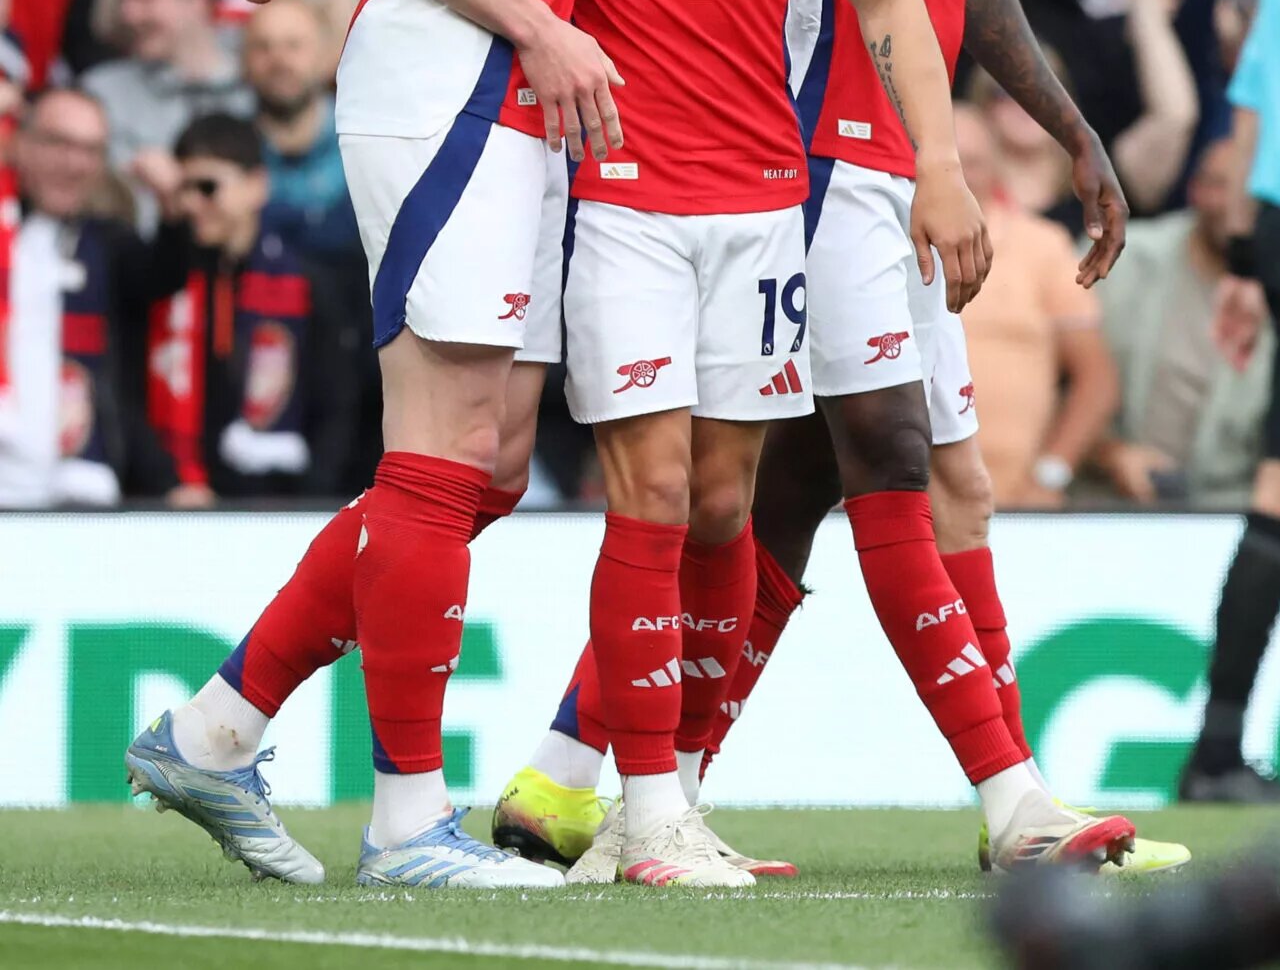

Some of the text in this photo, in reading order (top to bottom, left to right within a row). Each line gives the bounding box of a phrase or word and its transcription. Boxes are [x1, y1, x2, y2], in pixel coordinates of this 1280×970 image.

[758, 272, 807, 356] 19
[444, 604, 464, 621] A
[632, 615, 680, 631] AFC
[681, 612, 738, 633] AFC
